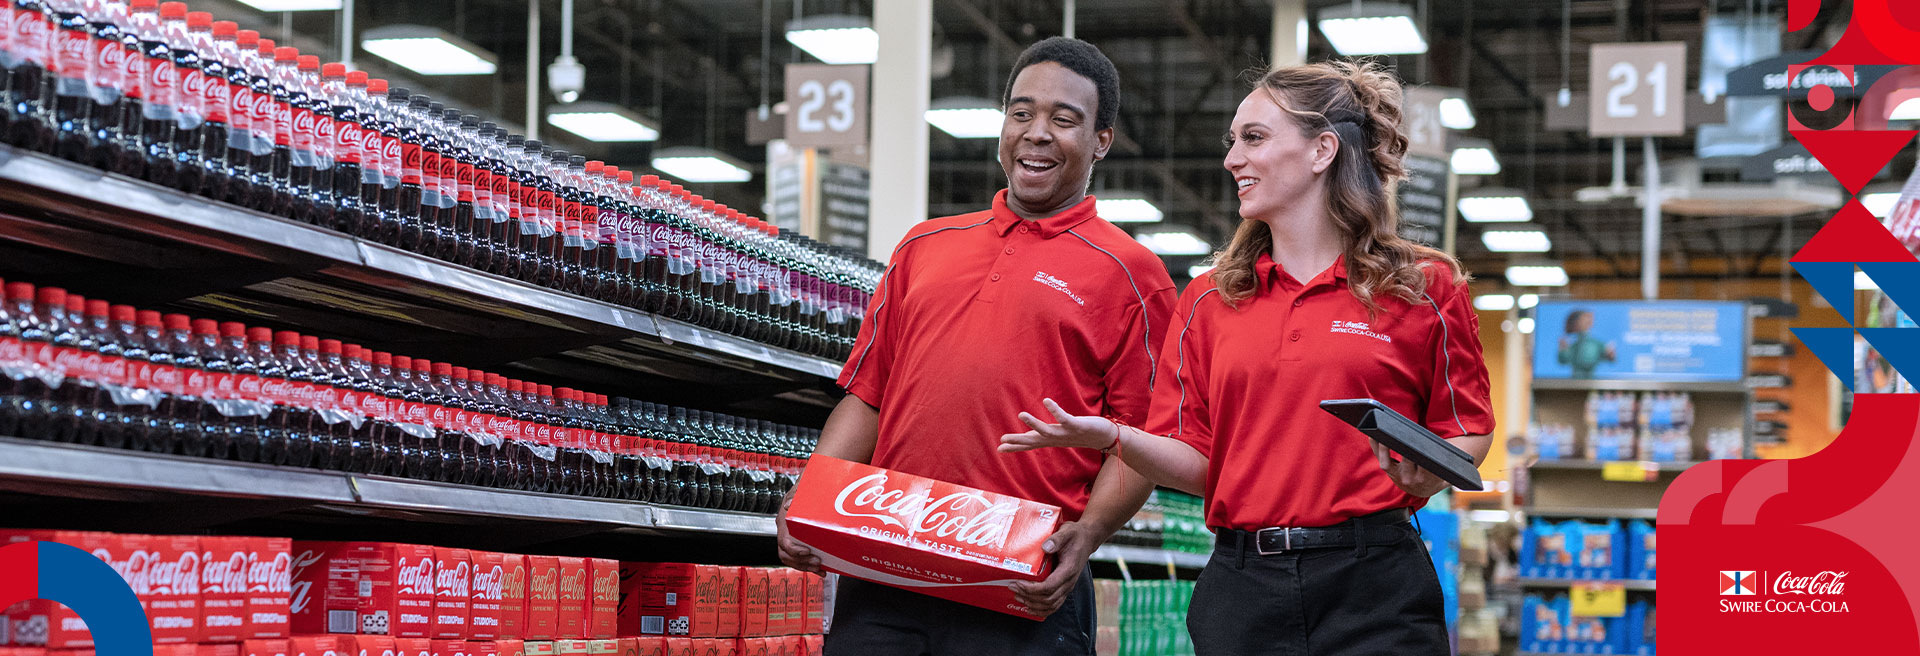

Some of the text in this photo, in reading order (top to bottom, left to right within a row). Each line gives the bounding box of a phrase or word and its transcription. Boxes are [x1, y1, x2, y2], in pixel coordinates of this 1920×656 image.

[1606, 61, 1668, 118] 21
[797, 79, 855, 133] 23
[834, 473, 1019, 547] Coca-Cola
[1039, 508, 1054, 519] 12
[860, 525, 919, 546] ORIGINAL
[924, 539, 963, 556] TASTE
[862, 555, 921, 573] ORIGINAL
[925, 570, 963, 583] TASTE
[400, 614, 428, 624] STUDIOPass
[438, 615, 464, 625] STUDIOPass
[473, 617, 498, 626] STUDIOPass
